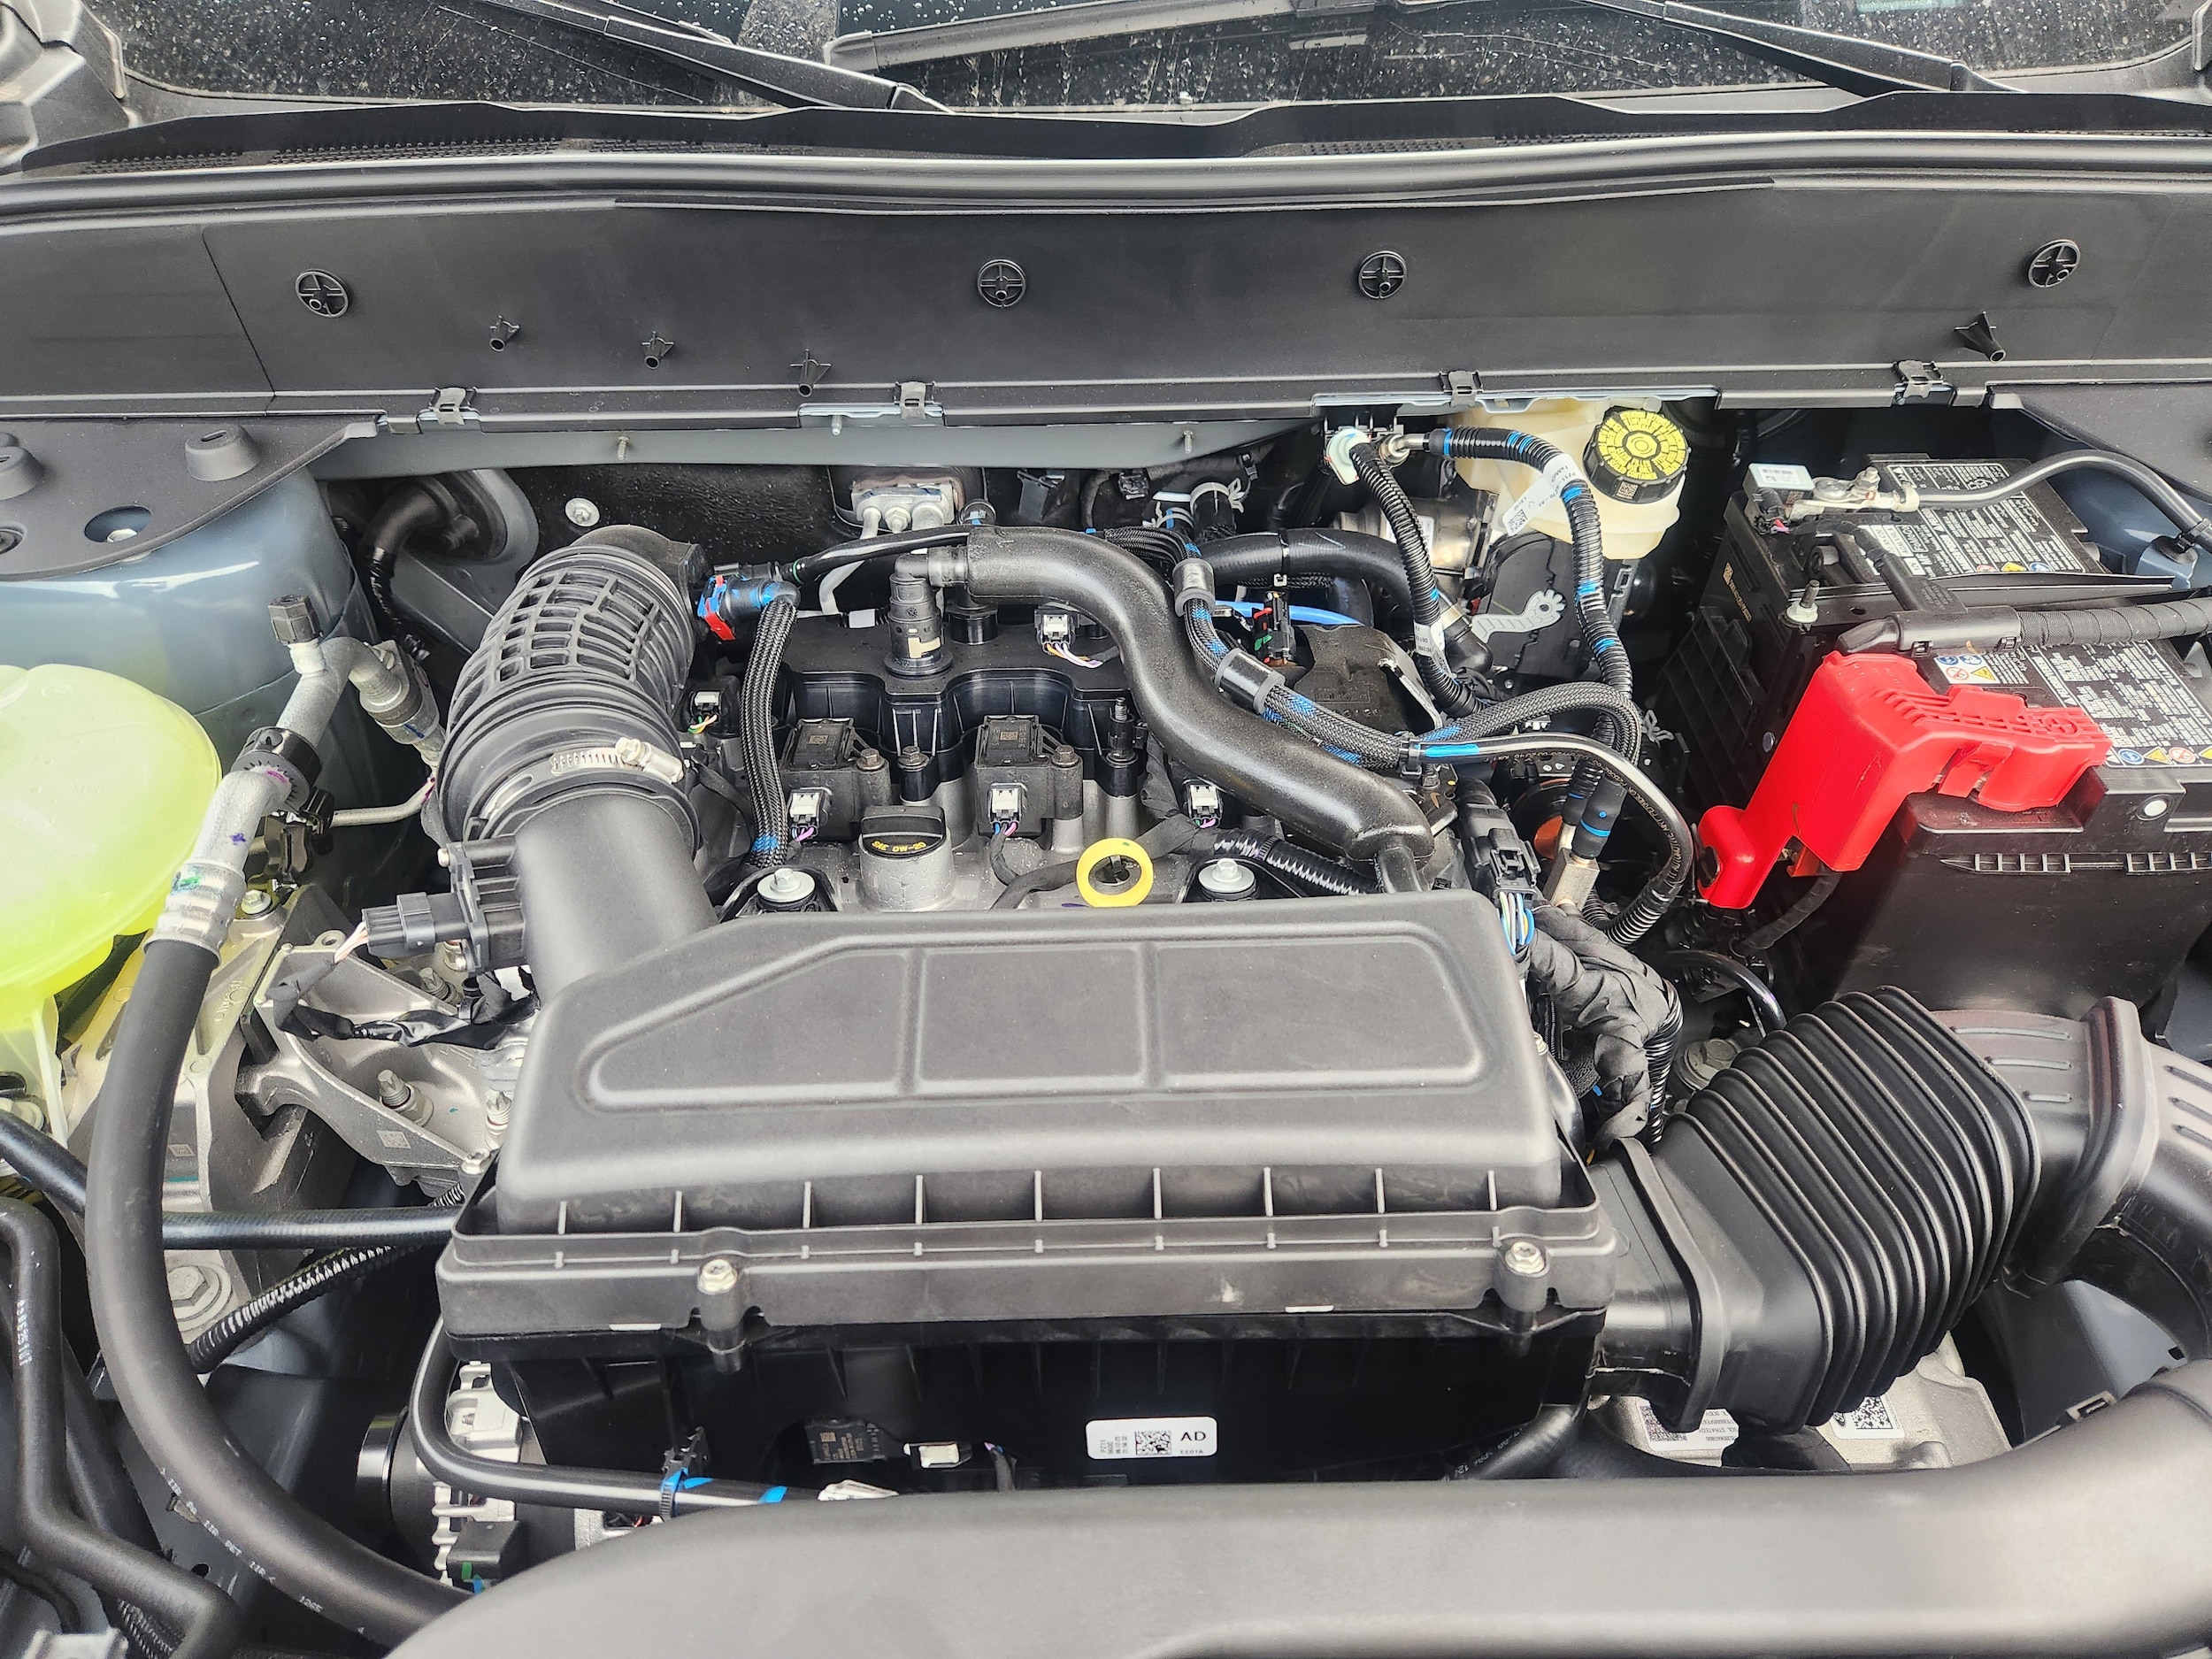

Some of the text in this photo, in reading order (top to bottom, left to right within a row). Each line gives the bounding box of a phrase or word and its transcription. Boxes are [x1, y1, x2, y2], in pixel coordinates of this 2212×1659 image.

[1901, 526, 1924, 551] FoMoCo
[871, 841, 927, 853] SAE 0W-20
[1180, 1431, 1206, 1441] AD
[224, 1540, 242, 1557] PET
